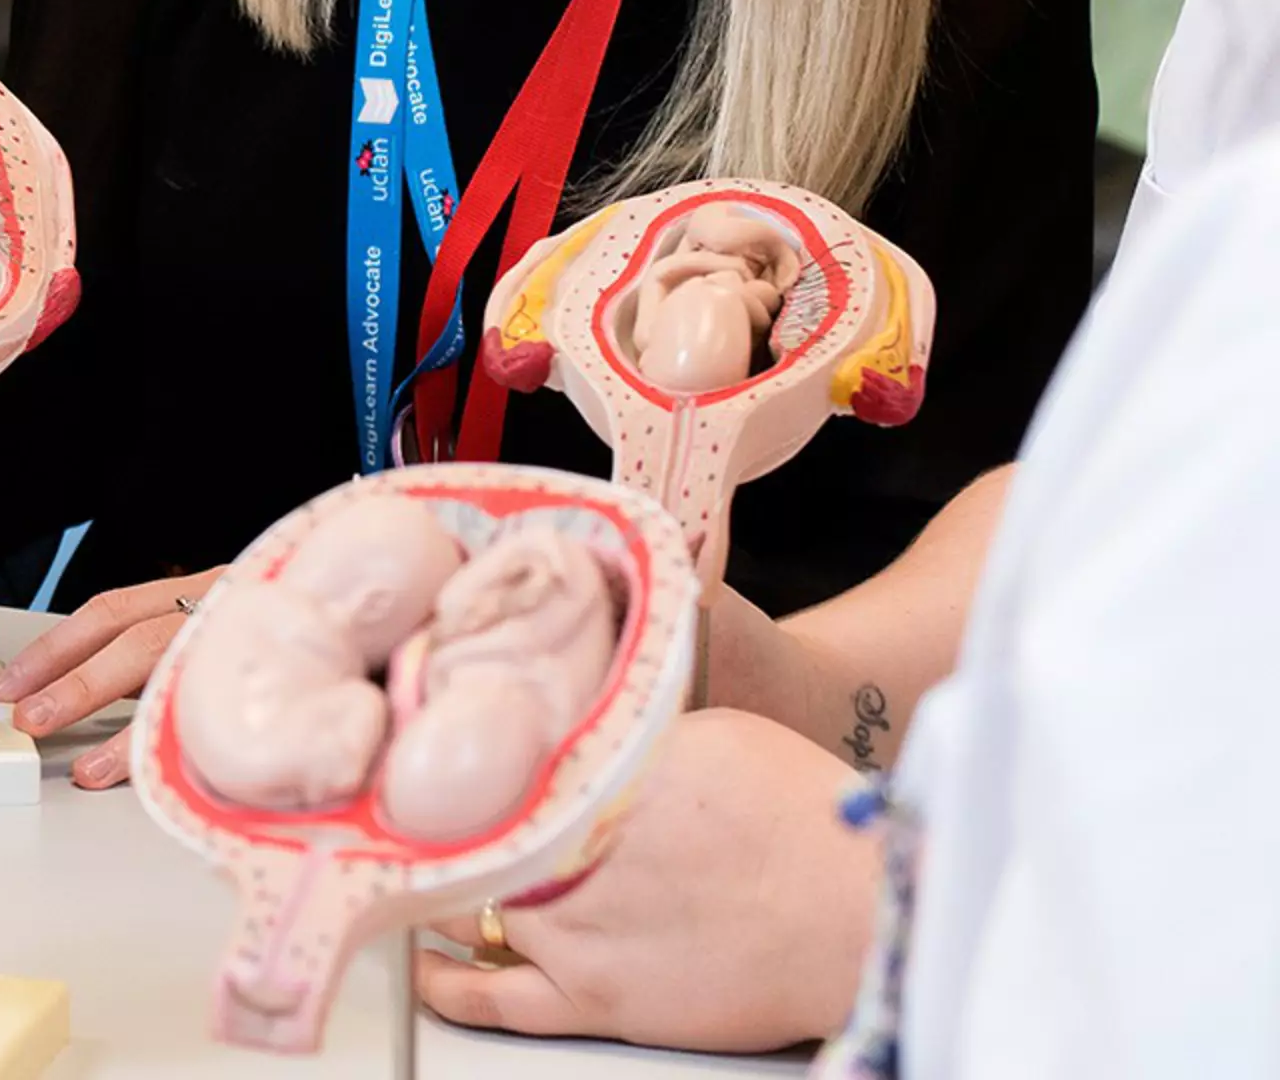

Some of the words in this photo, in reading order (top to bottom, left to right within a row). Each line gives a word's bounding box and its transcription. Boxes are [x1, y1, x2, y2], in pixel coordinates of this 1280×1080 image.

[369, 137, 389, 202] uclan
[419, 167, 445, 232] uclan
[361, 245, 382, 354] Advocate
[364, 358, 379, 467] DigiLearn
